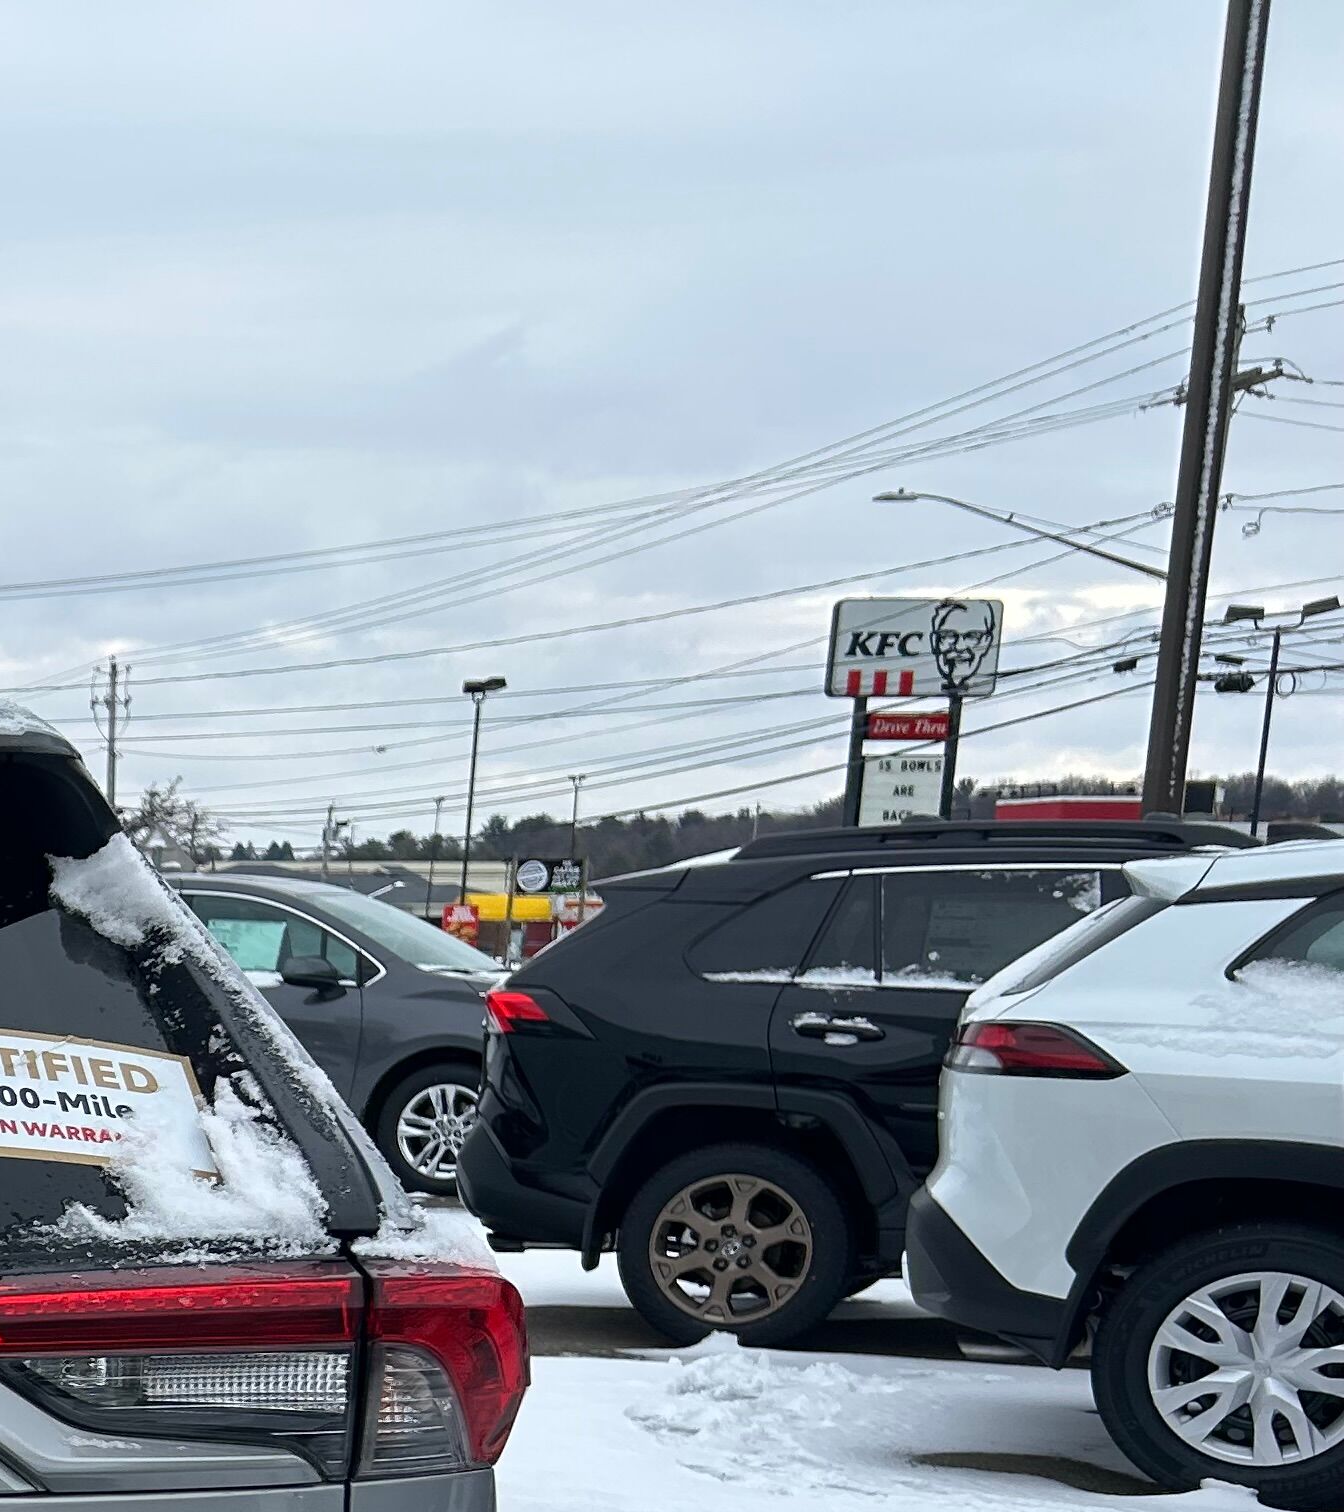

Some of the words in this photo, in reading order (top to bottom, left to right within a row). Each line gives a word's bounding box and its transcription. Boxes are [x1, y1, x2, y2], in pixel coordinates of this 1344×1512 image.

[844, 631, 924, 657] KFC
[873, 718, 910, 735] Drive
[914, 718, 948, 735] Thru
[900, 759, 942, 773] BOWLS
[893, 785, 915, 797] ARE
